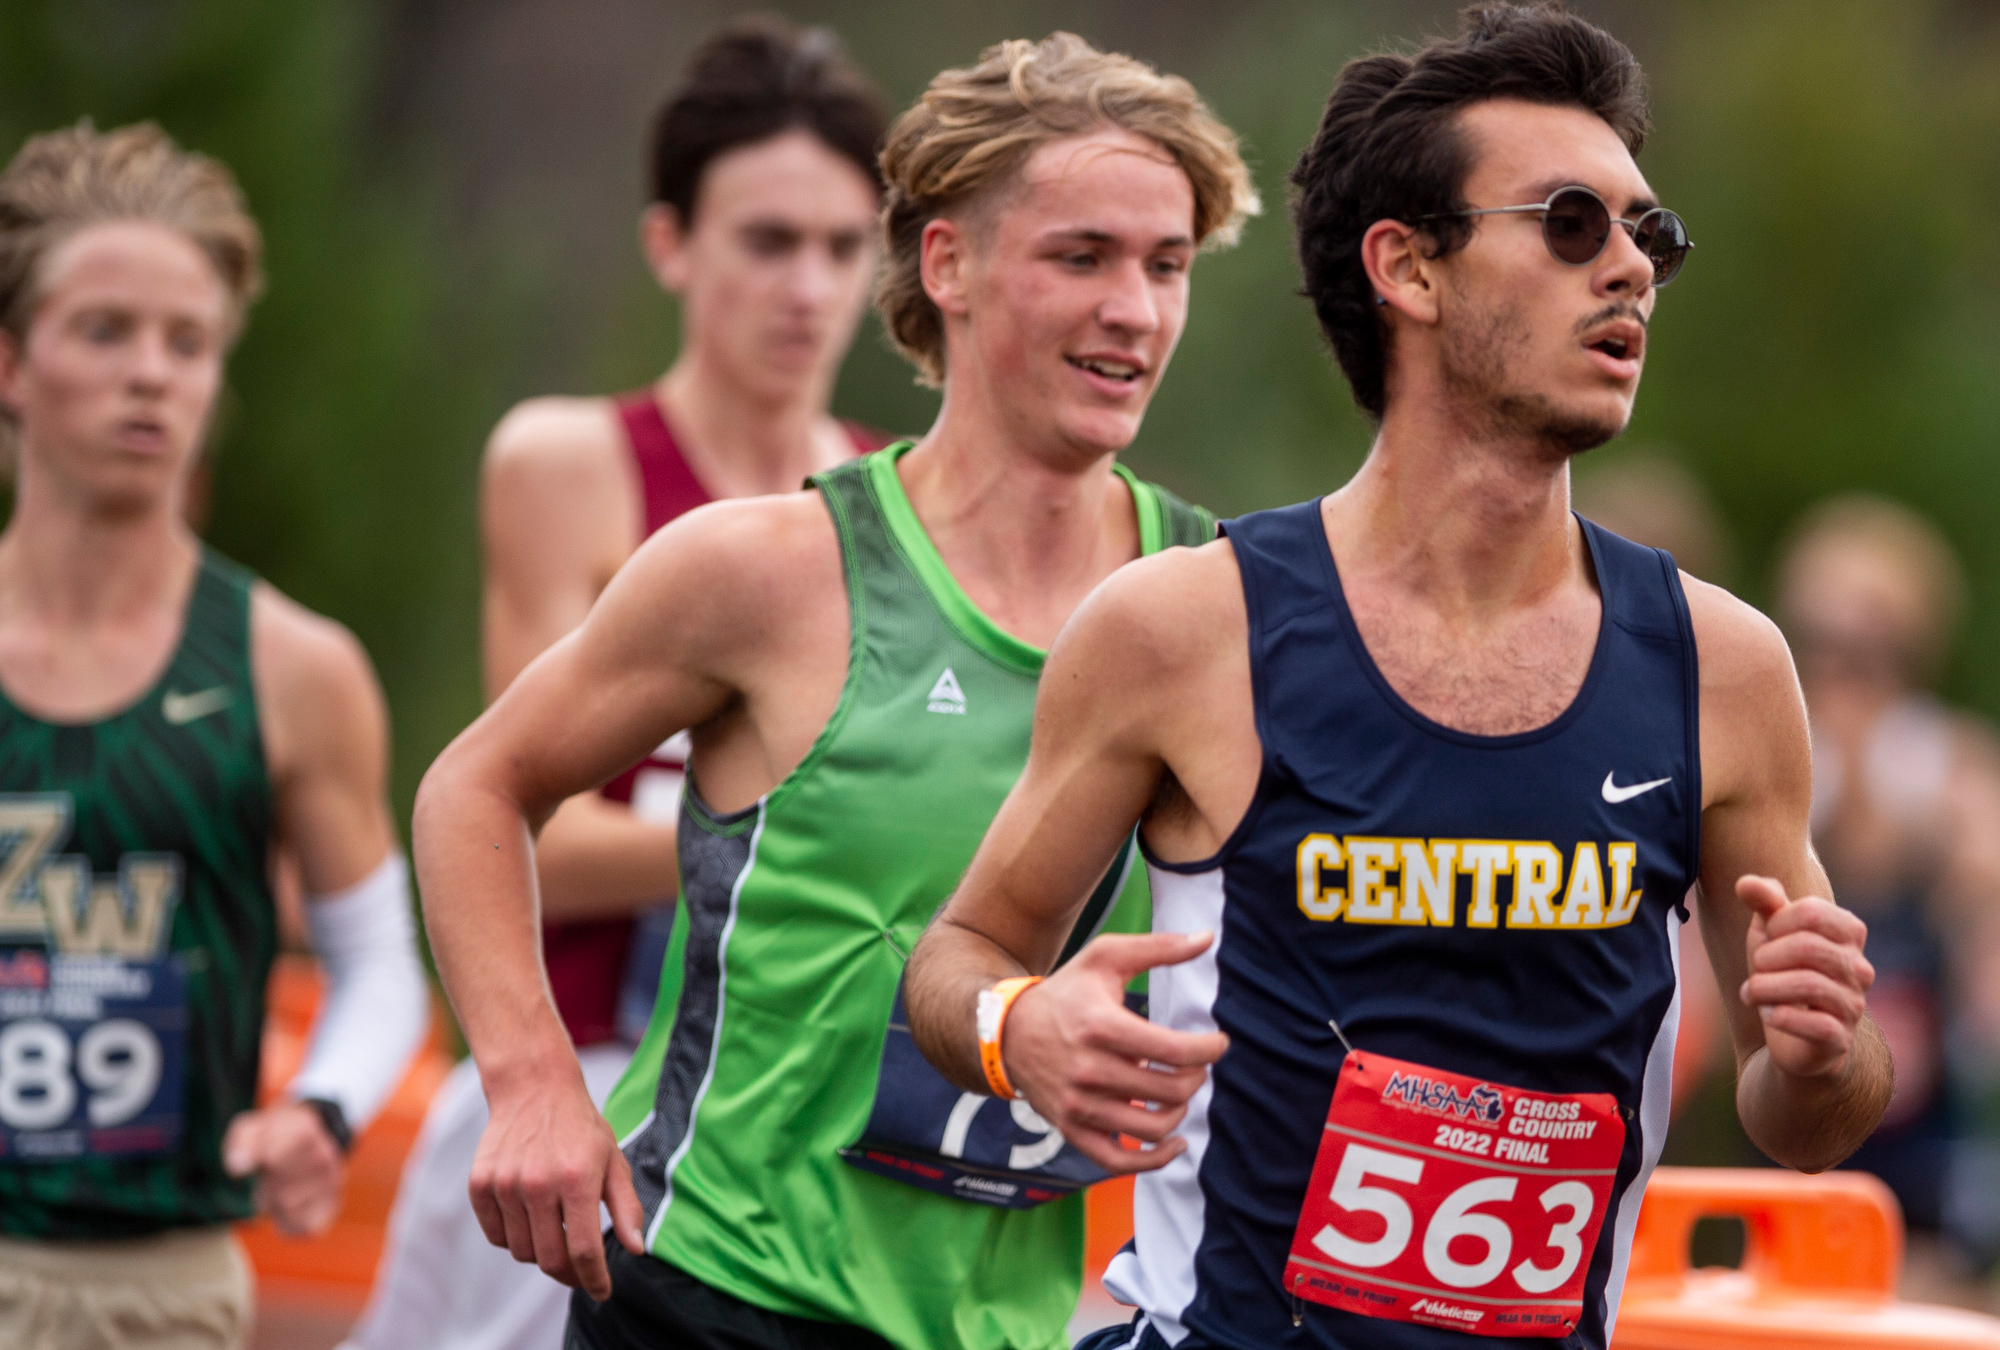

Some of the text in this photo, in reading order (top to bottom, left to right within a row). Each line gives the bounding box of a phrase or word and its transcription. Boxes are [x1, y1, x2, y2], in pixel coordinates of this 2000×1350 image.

[1296, 833, 1642, 930] CENTRAL
[1384, 1071, 1486, 1120] MHSAA
[1514, 1097, 1581, 1120] CROSS
[1434, 1124, 1550, 1164] 2022 FINAL
[1508, 1117, 1597, 1140] COUNTRY
[1312, 1143, 1594, 1294] 563
[1535, 1314, 1562, 1325] FRONT
